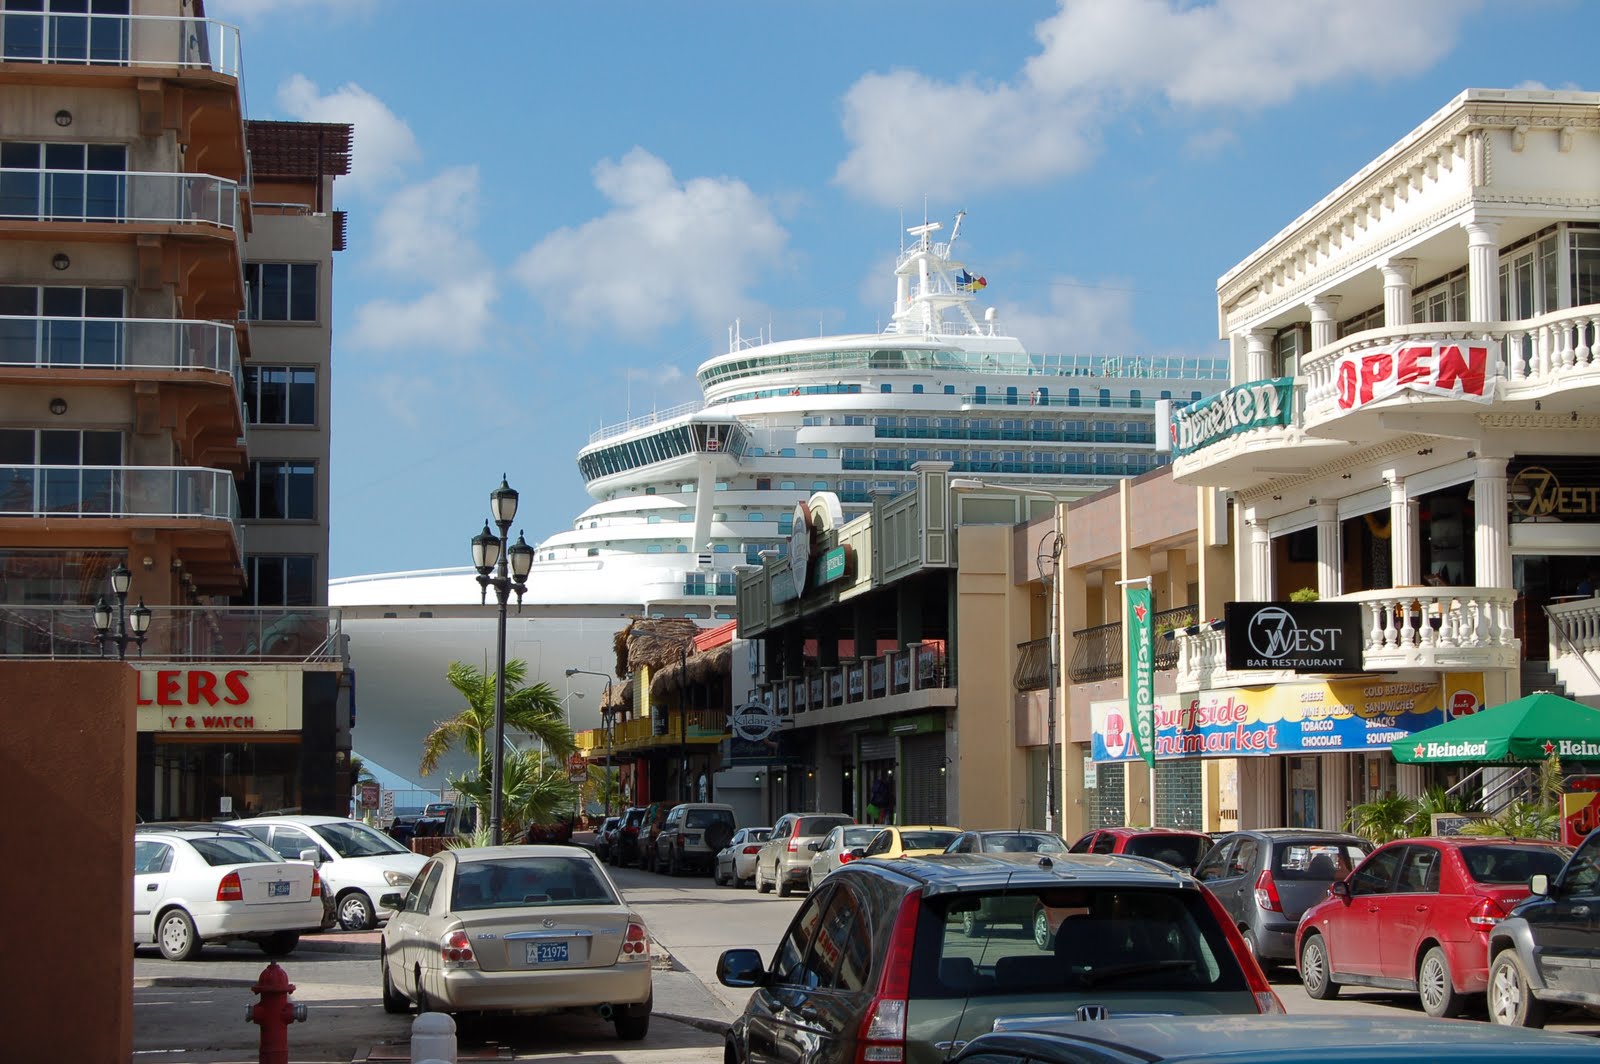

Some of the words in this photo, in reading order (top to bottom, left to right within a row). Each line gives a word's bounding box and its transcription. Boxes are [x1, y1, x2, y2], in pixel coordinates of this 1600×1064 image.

[1337, 346, 1487, 410] OPEN
[1265, 628, 1343, 652] WEST
[1246, 659, 1269, 667] BAR
[1272, 658, 1344, 667] RESTAURANT
[1136, 626, 1153, 753] Heineken
[1364, 686, 1384, 698] COLD
[1300, 691, 1324, 702] CHEESE
[1301, 706, 1319, 717] WINE
[1320, 707, 1327, 716] &
[1328, 704, 1355, 716] LIQUOR
[1365, 699, 1415, 714] SANDWICHES
[1153, 697, 1249, 732] Surfside
[168, 716, 178, 728] Y
[185, 716, 196, 728] &
[202, 716, 254, 728] WATCH
[1301, 719, 1334, 732] TOBACCO
[1365, 716, 1396, 729] SNACKS
[1301, 735, 1342, 748] CHOCOLATE
[1559, 740, 1600, 756] Hein
[1427, 740, 1487, 758] Heineken
